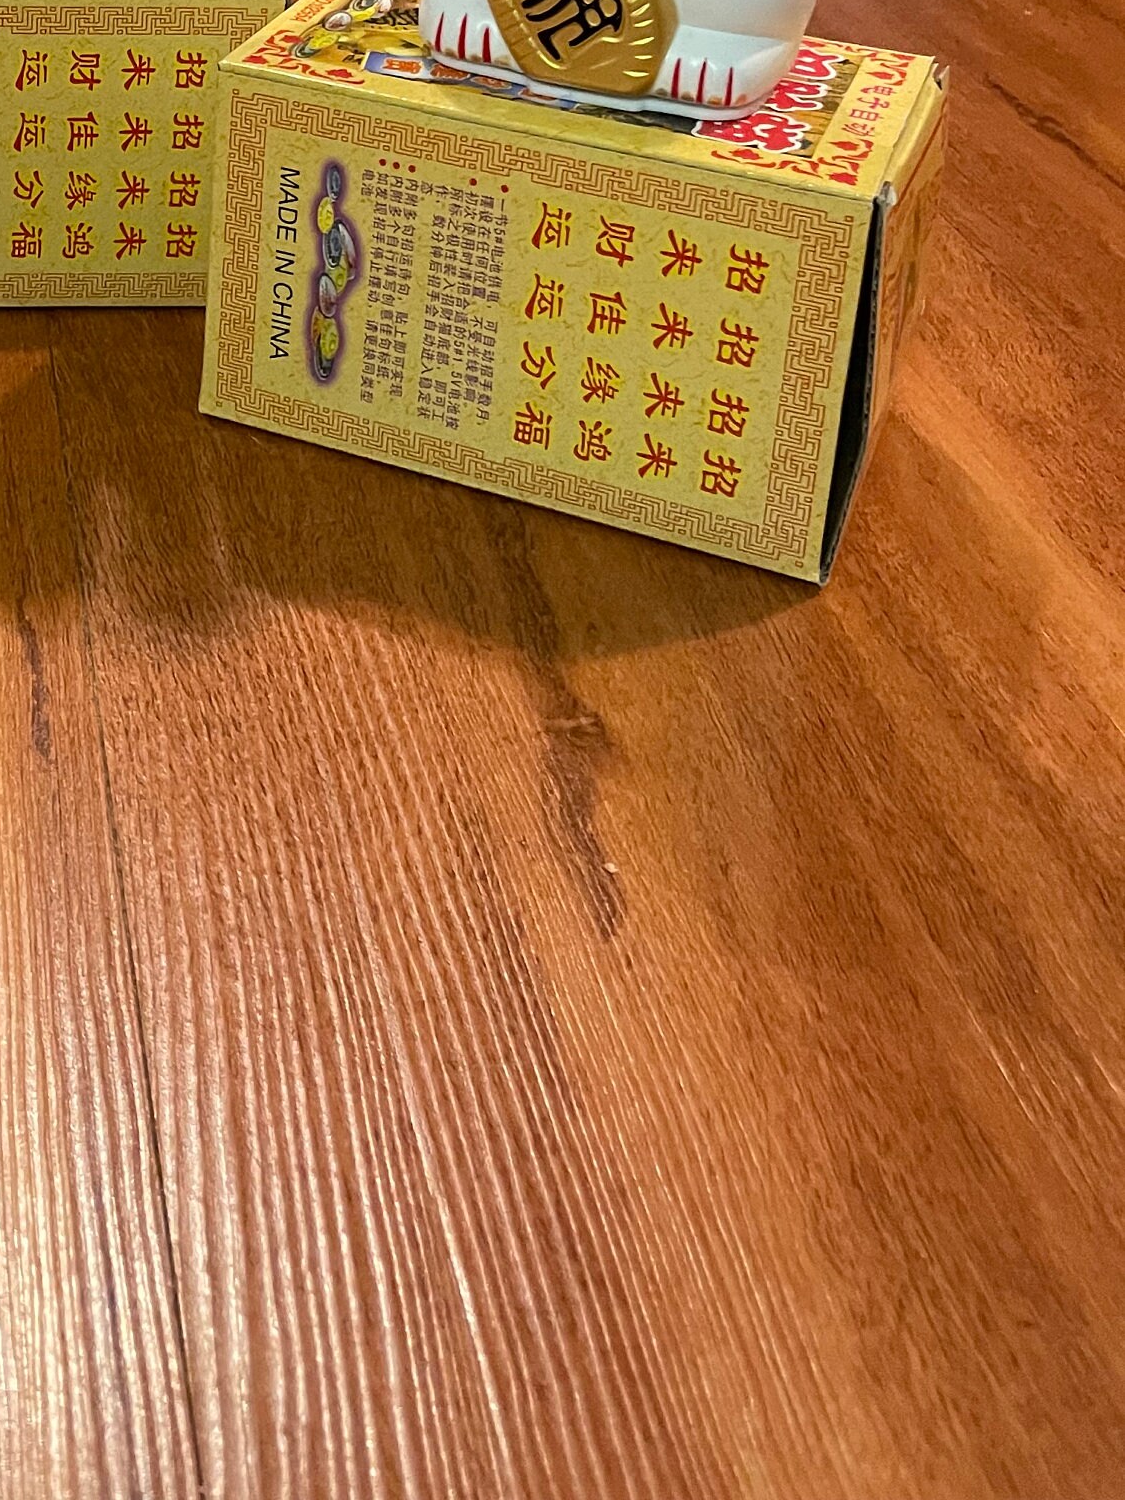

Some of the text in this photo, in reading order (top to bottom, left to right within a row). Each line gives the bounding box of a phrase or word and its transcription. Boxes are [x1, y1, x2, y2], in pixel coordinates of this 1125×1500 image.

[843, 86, 896, 138] 电子自动
[269, 165, 301, 360] MADE IN CHINA
